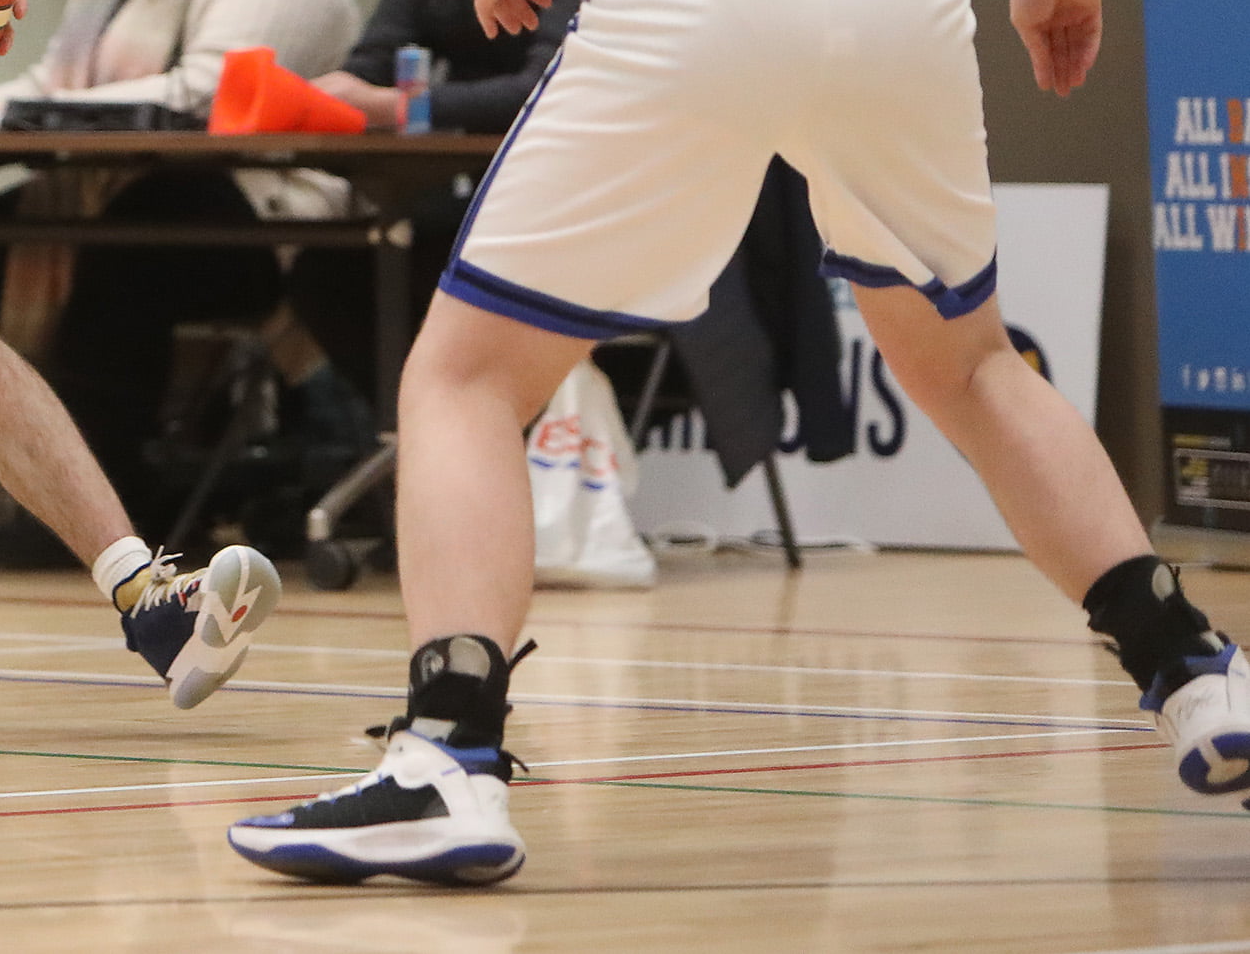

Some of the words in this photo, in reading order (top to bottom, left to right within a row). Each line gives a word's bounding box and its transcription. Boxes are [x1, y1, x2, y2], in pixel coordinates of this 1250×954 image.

[1174, 97, 1225, 144] ALL
[1165, 152, 1217, 200] ALL
[1154, 203, 1203, 251] ALL
